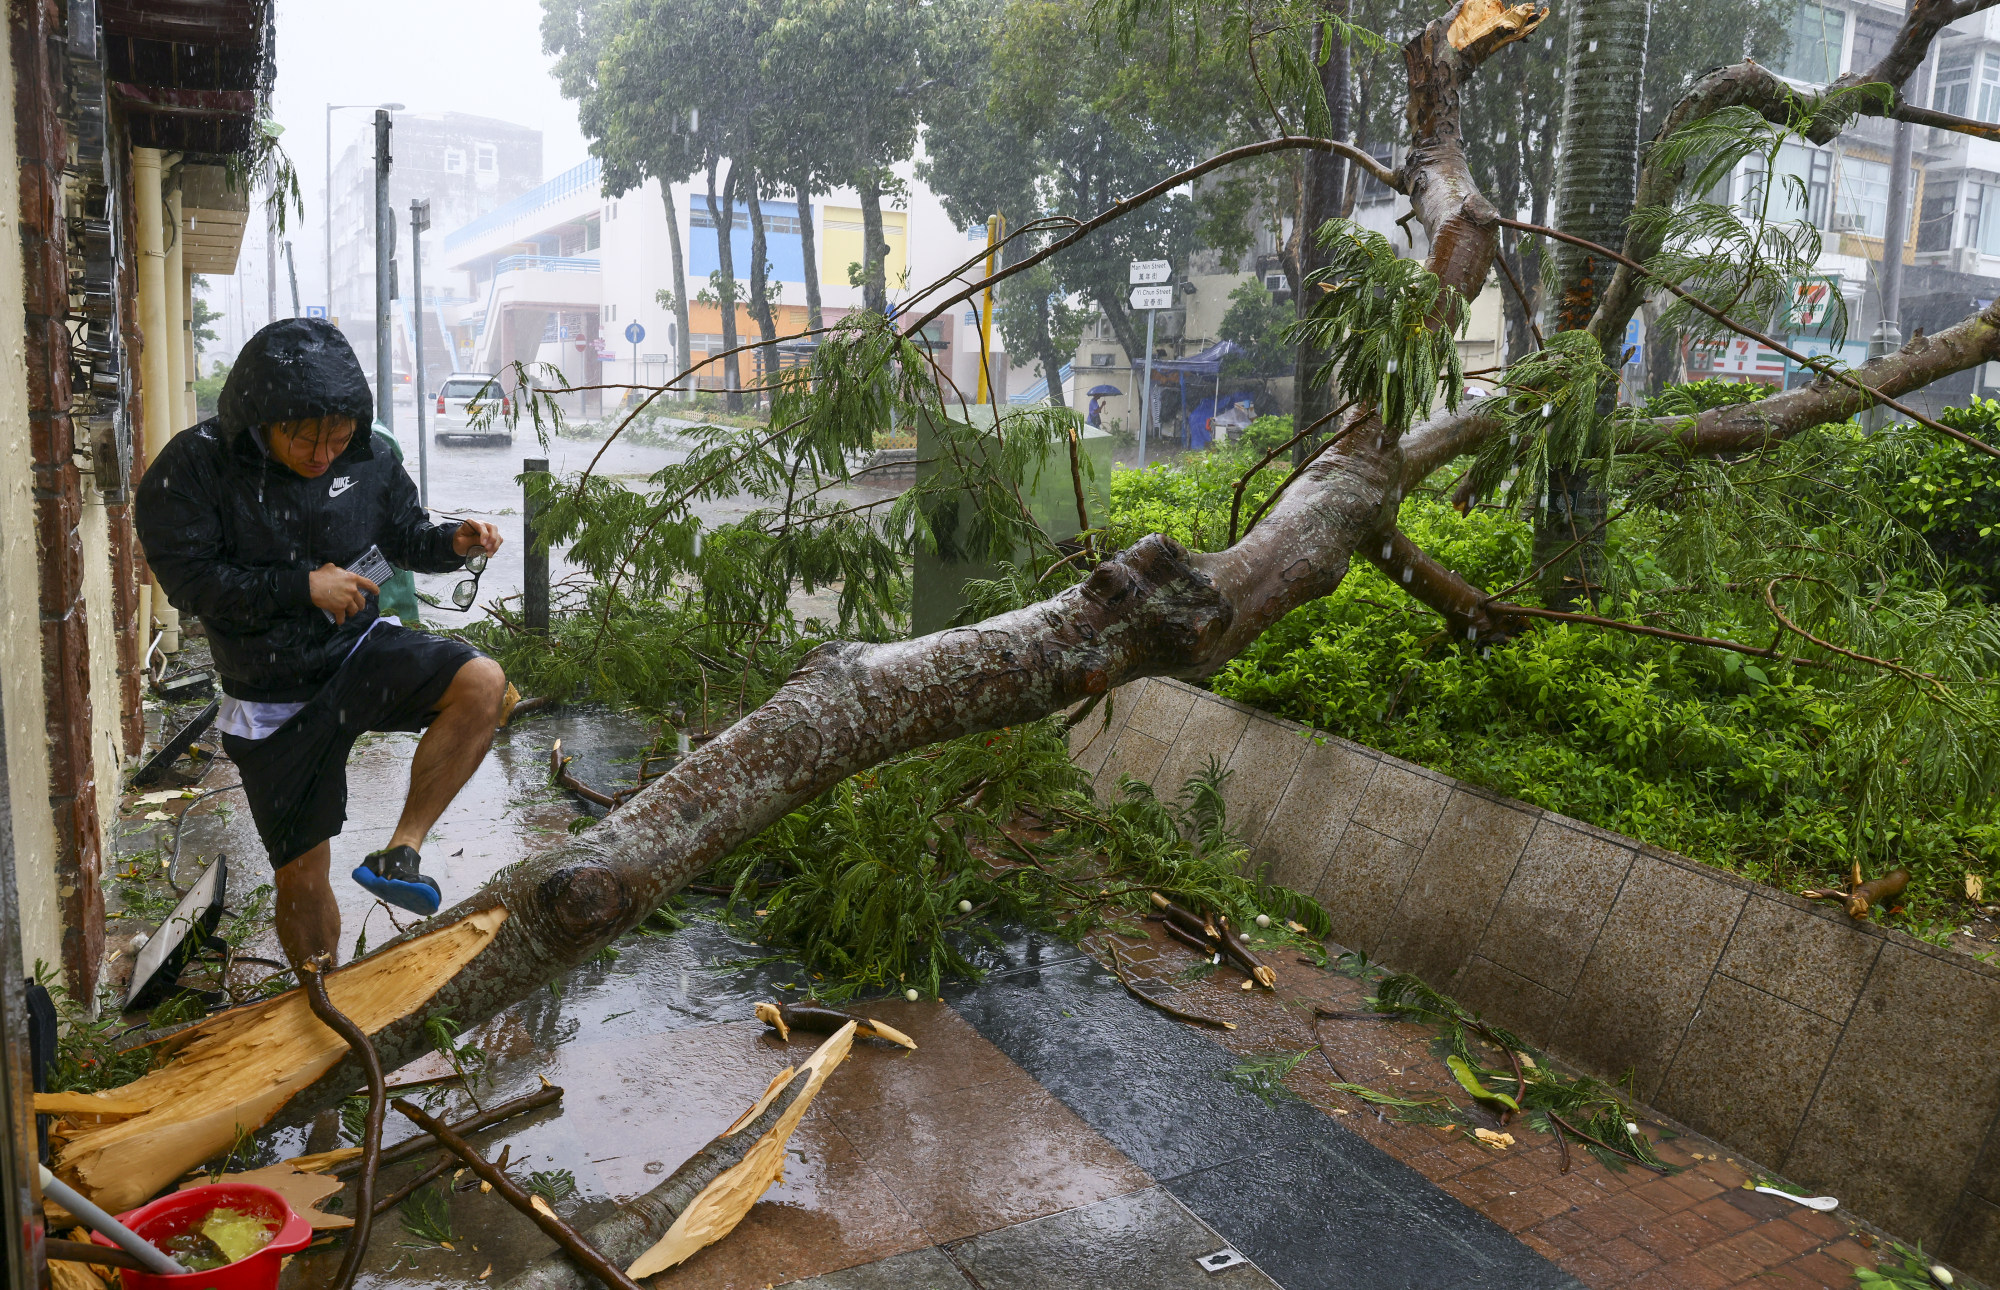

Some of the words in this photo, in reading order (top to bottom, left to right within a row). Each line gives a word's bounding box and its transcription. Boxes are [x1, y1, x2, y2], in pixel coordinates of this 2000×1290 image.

[1151, 262, 1166, 270] Street
[1798, 285, 1827, 324] 7
[1626, 321, 1637, 340] P
[1736, 340, 1749, 371] 7
[332, 476, 350, 488] NIKE
